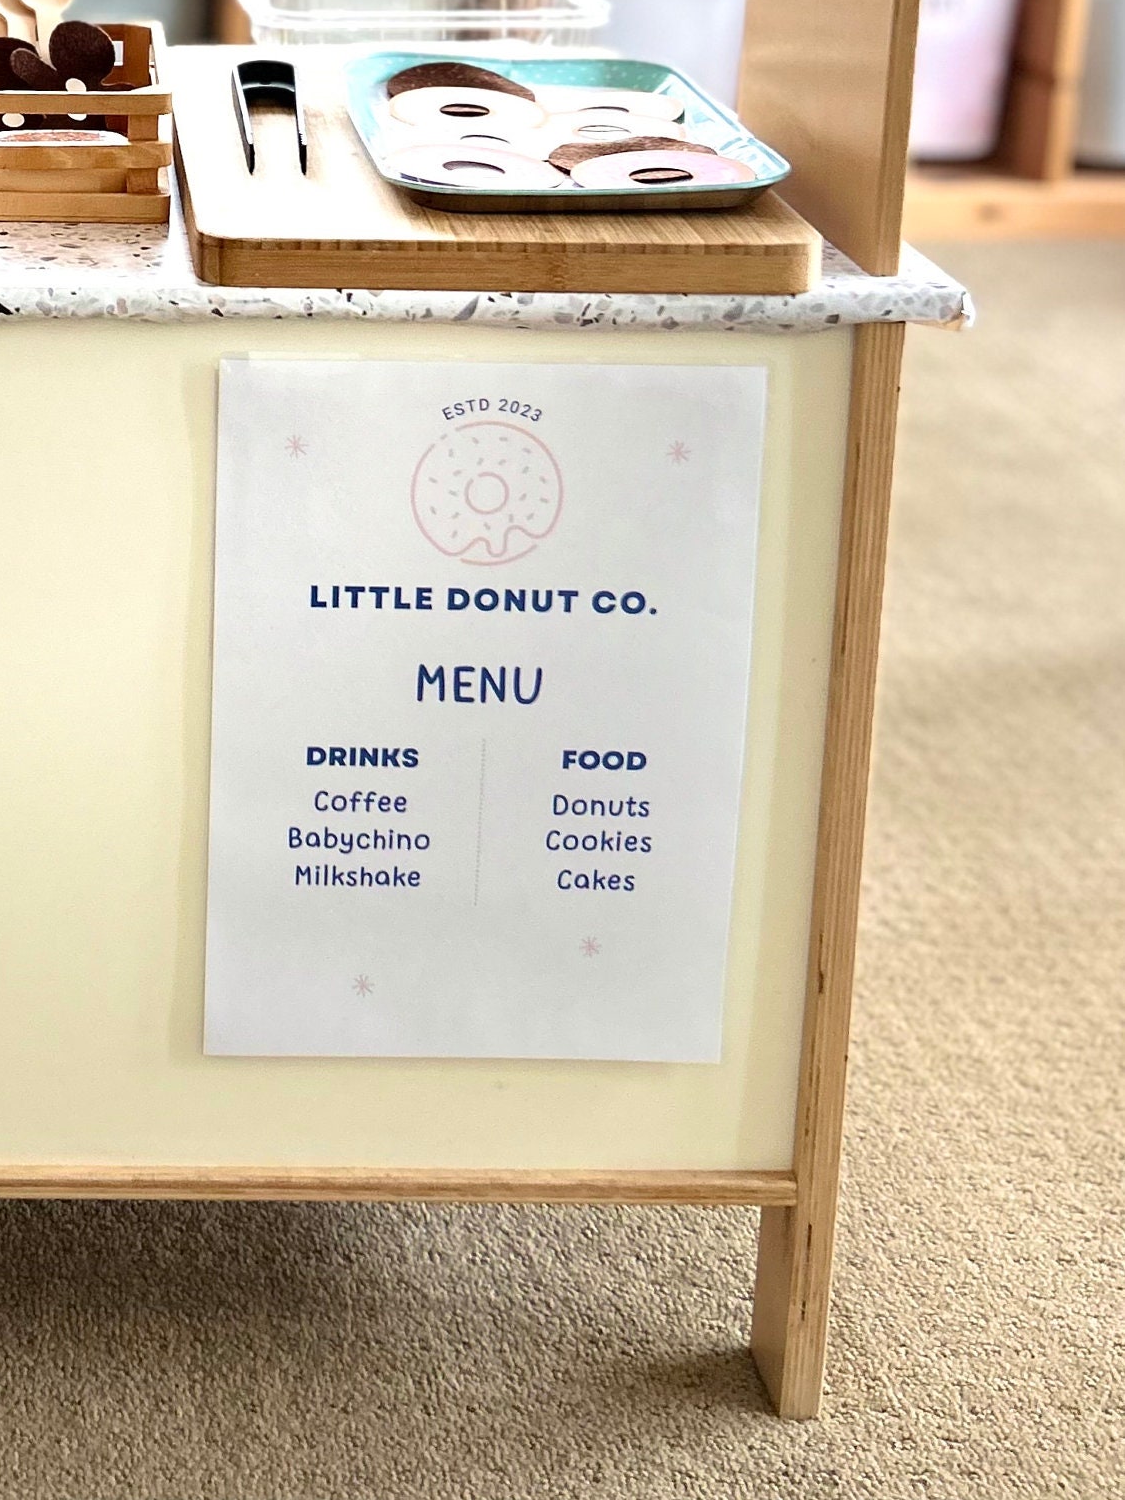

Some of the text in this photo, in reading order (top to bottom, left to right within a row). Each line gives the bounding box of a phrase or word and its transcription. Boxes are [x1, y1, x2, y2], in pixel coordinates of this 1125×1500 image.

[441, 398, 544, 423] ESTD 2023
[310, 584, 657, 615] LITTLE DONUT CO.
[416, 663, 543, 705] MENU
[306, 746, 419, 768] DRINKS
[562, 750, 647, 771] FOOD
[314, 790, 407, 813] Coffee
[552, 794, 650, 818] Donuts
[288, 826, 430, 855] Babychino
[545, 829, 652, 853] Cookies
[295, 864, 421, 888] Milkshake
[557, 869, 635, 892] Cakes
